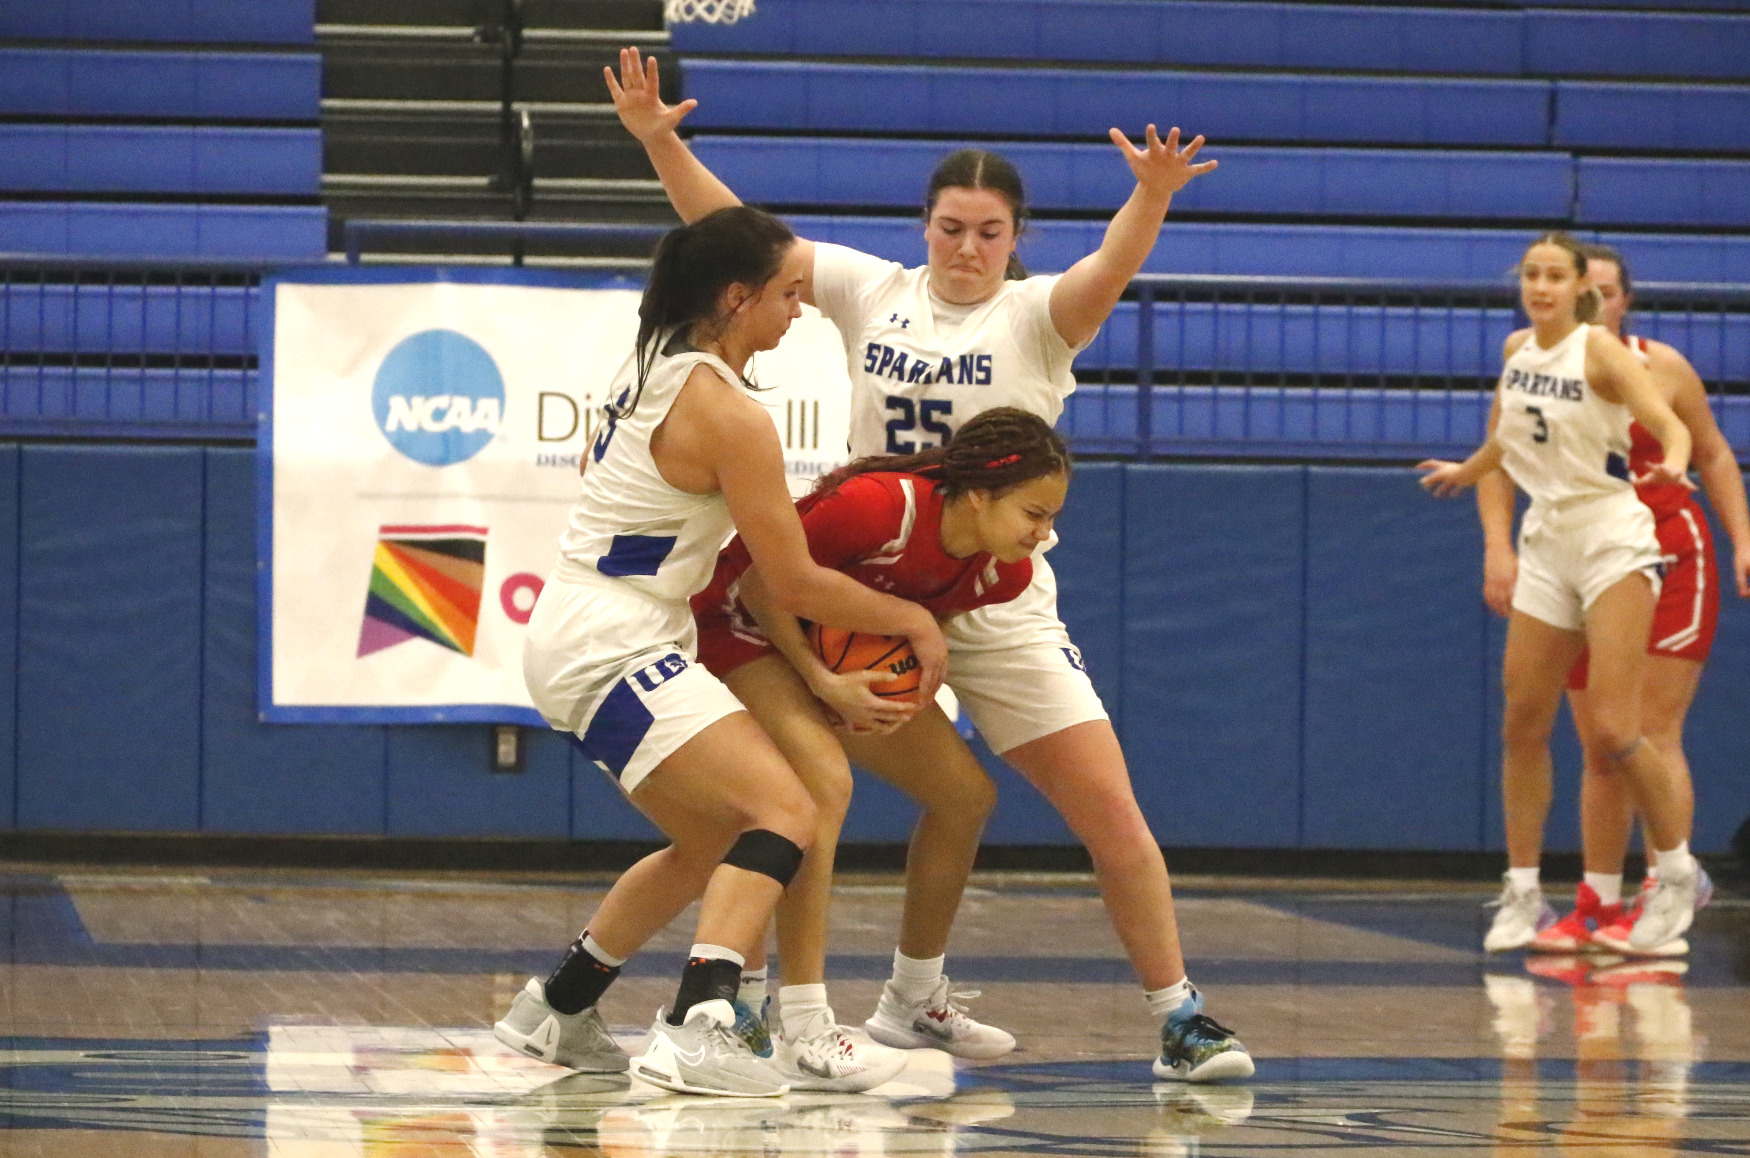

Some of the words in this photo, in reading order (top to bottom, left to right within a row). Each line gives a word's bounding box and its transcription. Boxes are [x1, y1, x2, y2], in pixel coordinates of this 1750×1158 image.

[385, 394, 501, 433] NCAA
[537, 391, 603, 442] Di
[885, 395, 953, 455] 25
[1525, 405, 1549, 443] 3
